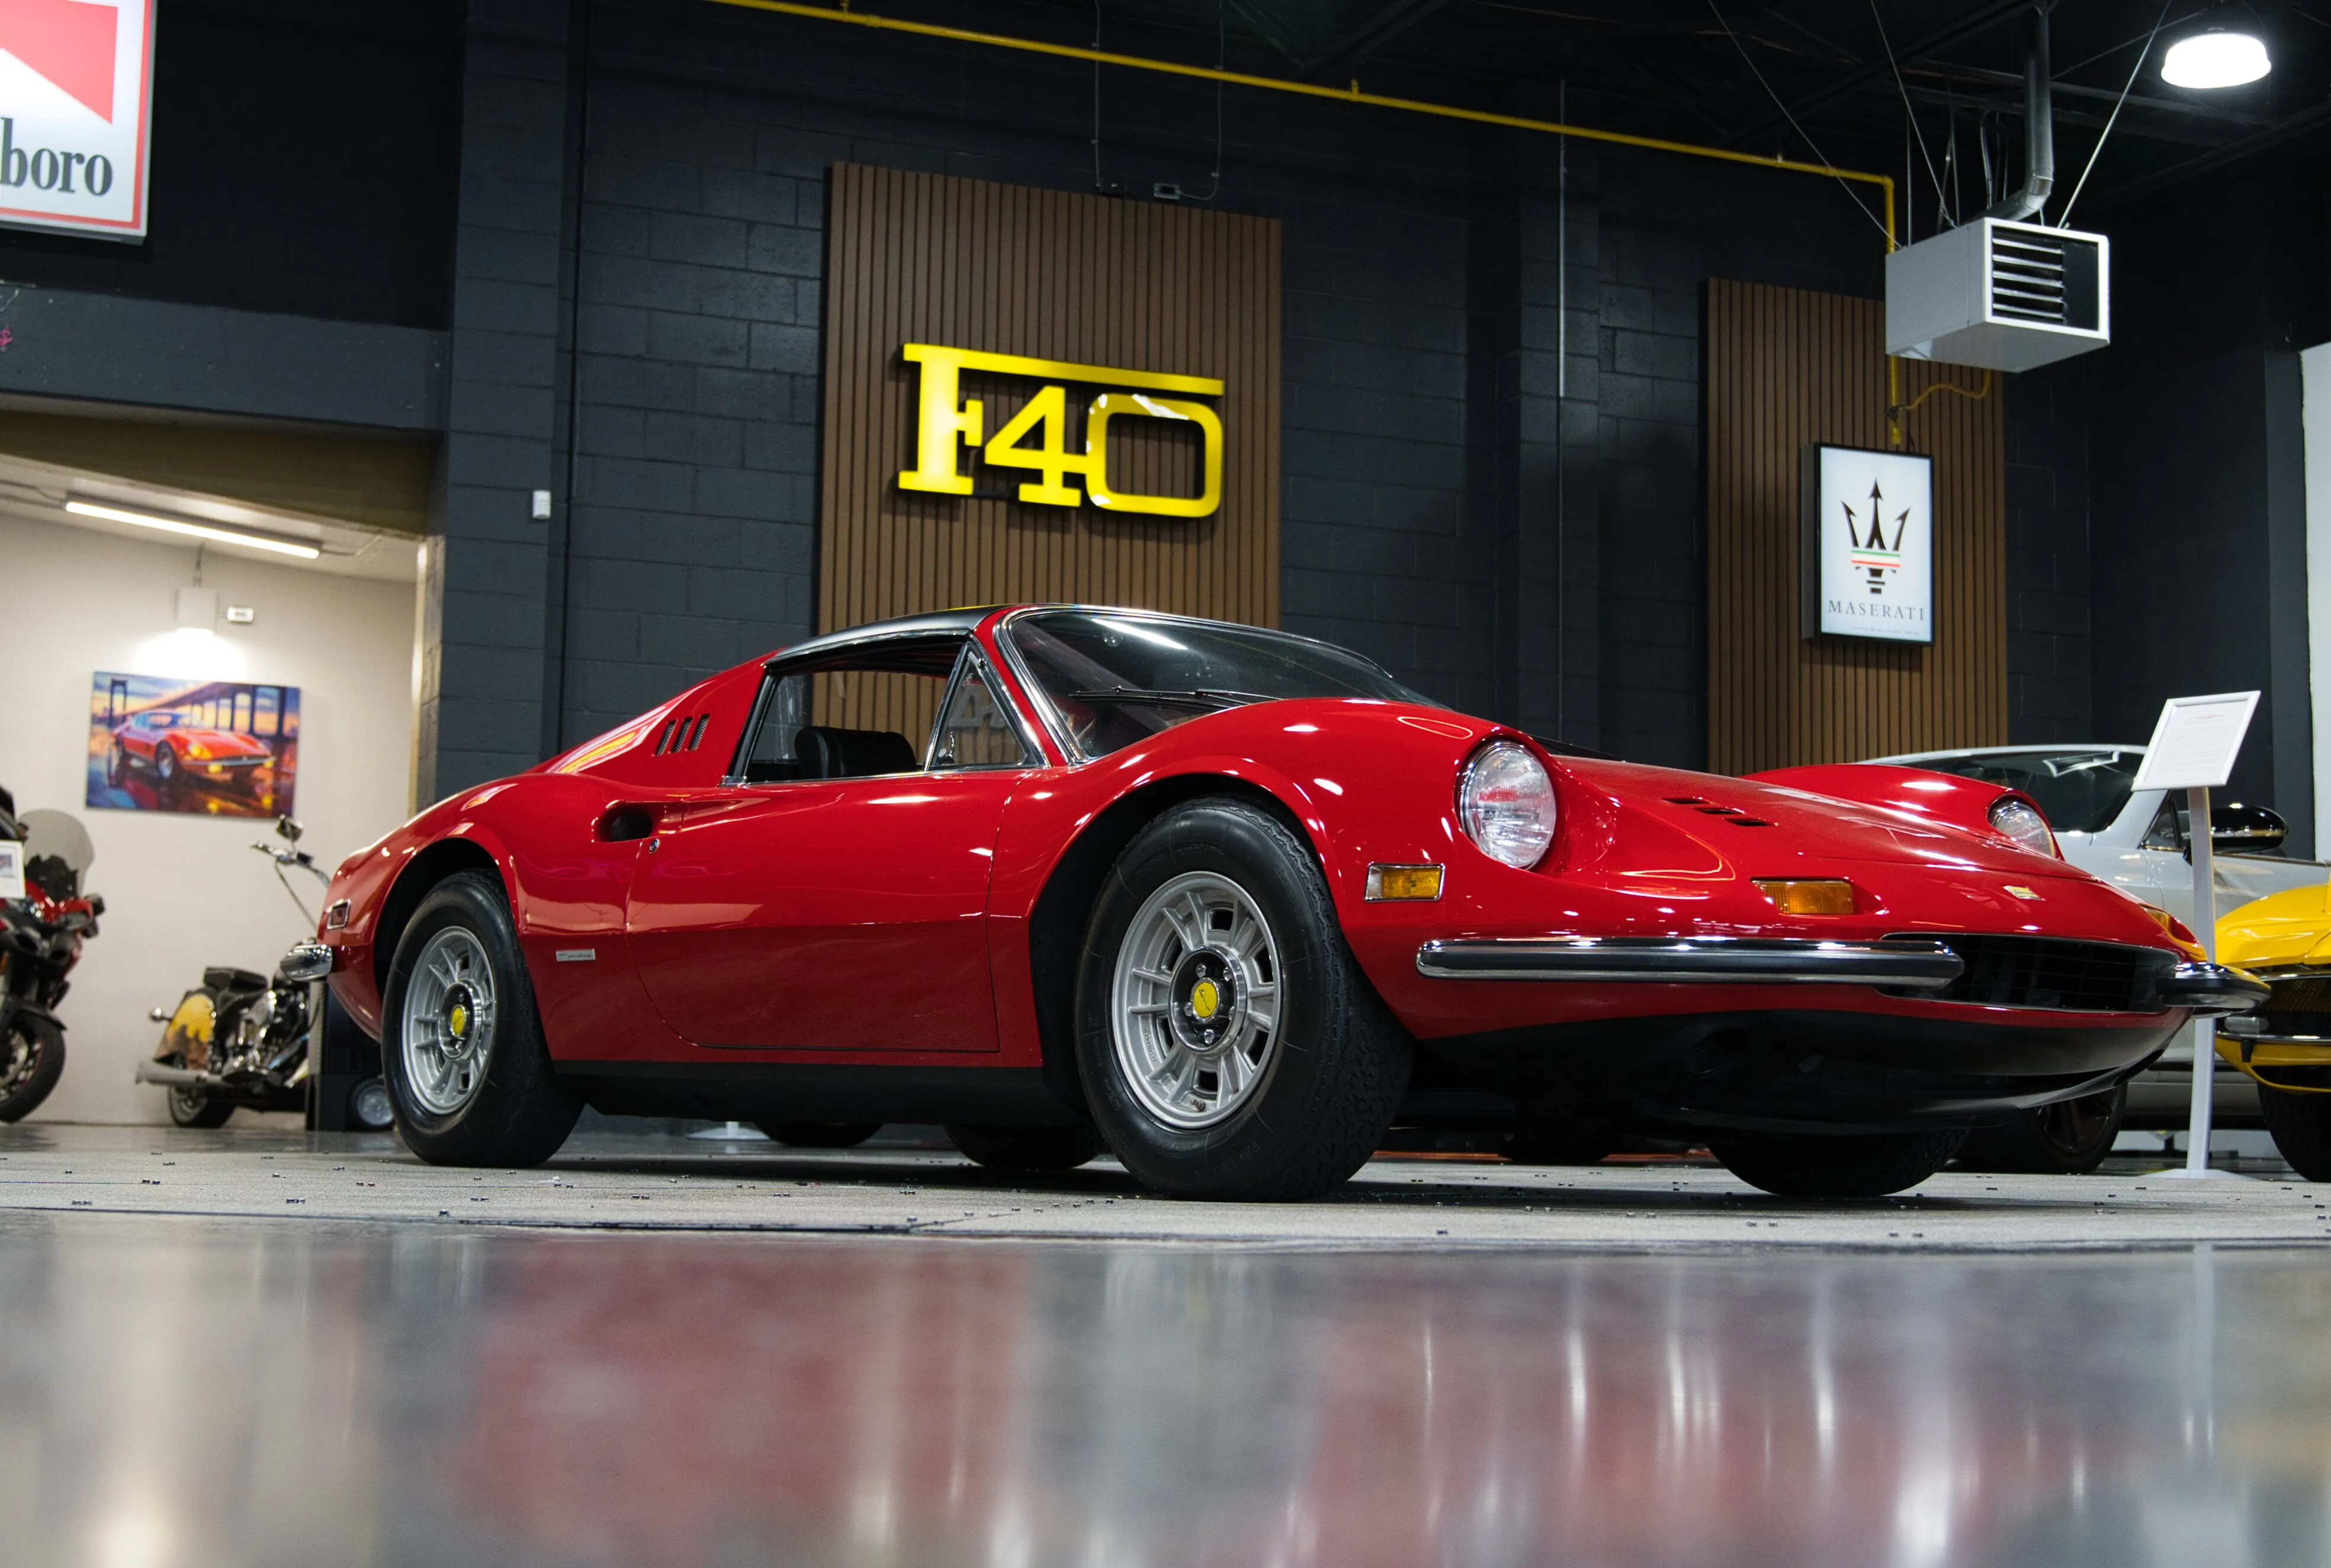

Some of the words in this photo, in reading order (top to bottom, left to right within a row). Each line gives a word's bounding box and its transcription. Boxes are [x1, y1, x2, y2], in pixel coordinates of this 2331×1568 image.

[0, 117, 113, 197] boro
[898, 343, 1224, 518] F40
[1828, 600, 1925, 621] MASERATI
